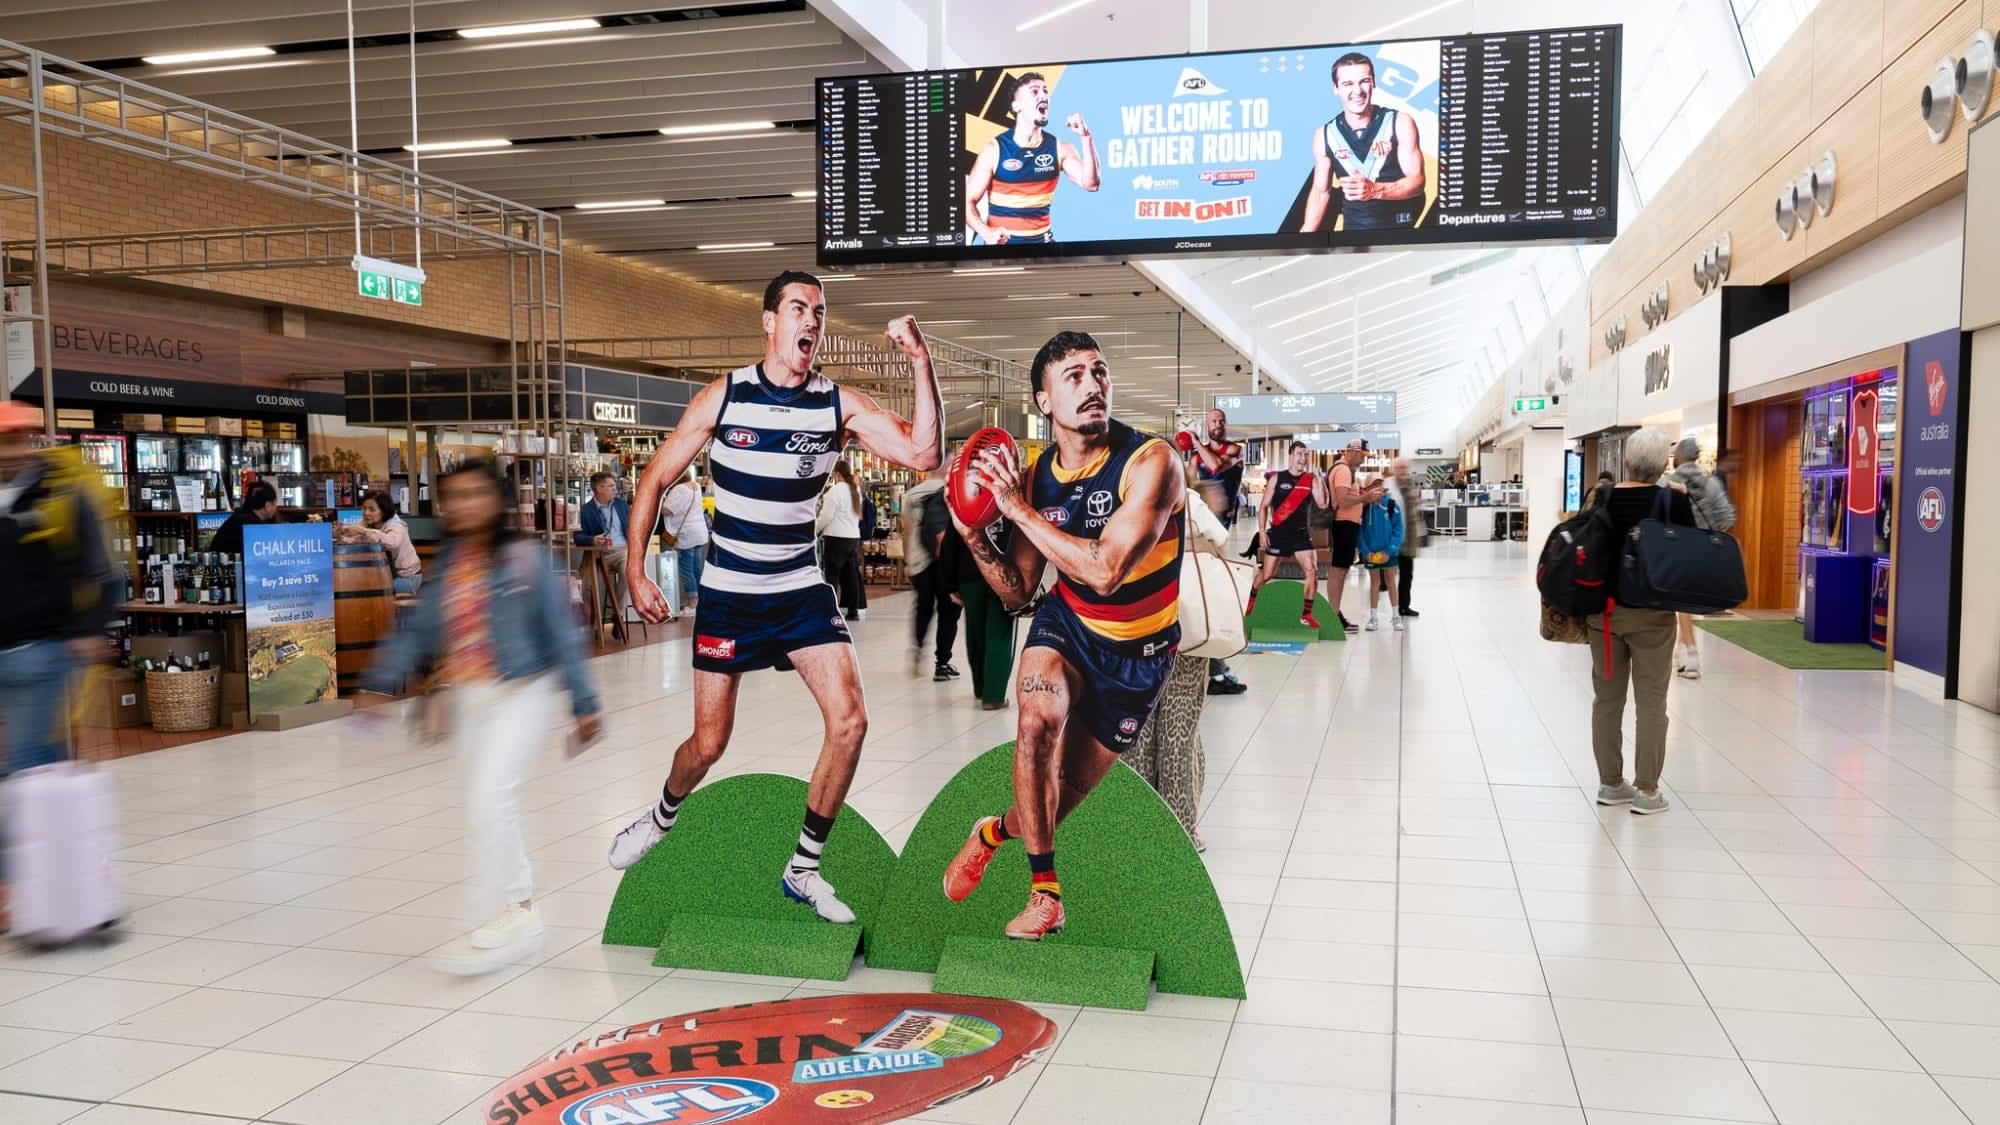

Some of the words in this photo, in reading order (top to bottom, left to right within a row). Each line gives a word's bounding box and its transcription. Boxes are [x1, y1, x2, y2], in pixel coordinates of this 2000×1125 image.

[1120, 101, 1233, 135] WELCOME
[1240, 97, 1269, 129] TO
[1108, 135, 1195, 169] GATHER
[1202, 131, 1282, 164] ROUND
[1139, 201, 1160, 217] GET
[1164, 201, 1191, 217] IN
[1195, 201, 1233, 220] ON
[1237, 199, 1248, 214] IT
[1439, 213, 1506, 226] Departures
[825, 239, 863, 249] Arrivals
[1175, 241, 1212, 249] JCDecaux
[53, 325, 204, 362] BEVERAGES
[90, 381, 117, 393] COLD
[120, 383, 141, 395] BEER
[143, 386, 149, 396] &
[151, 387, 175, 398] WINE
[256, 394, 277, 406] COLD
[279, 396, 305, 407] DRINKS
[1228, 399, 1241, 409] 19
[1282, 396, 1316, 408] 20-50
[593, 402, 636, 423] CIRELLI
[728, 432, 756, 443] AFL
[1920, 423, 1950, 441] australia
[785, 432, 832, 453] Ford
[1920, 498, 1943, 520] AFL
[253, 540, 295, 556] CHALK
[298, 538, 325, 553] HILL
[262, 577, 277, 588] Buy
[279, 576, 284, 585] 2
[285, 576, 302, 585] save
[304, 573, 319, 584] 15%
[270, 612, 292, 622] valued
[873, 1014, 937, 1051] BAROSSA
[799, 1052, 928, 1081] ADELAIDE
[582, 1084, 770, 1125] AFL
